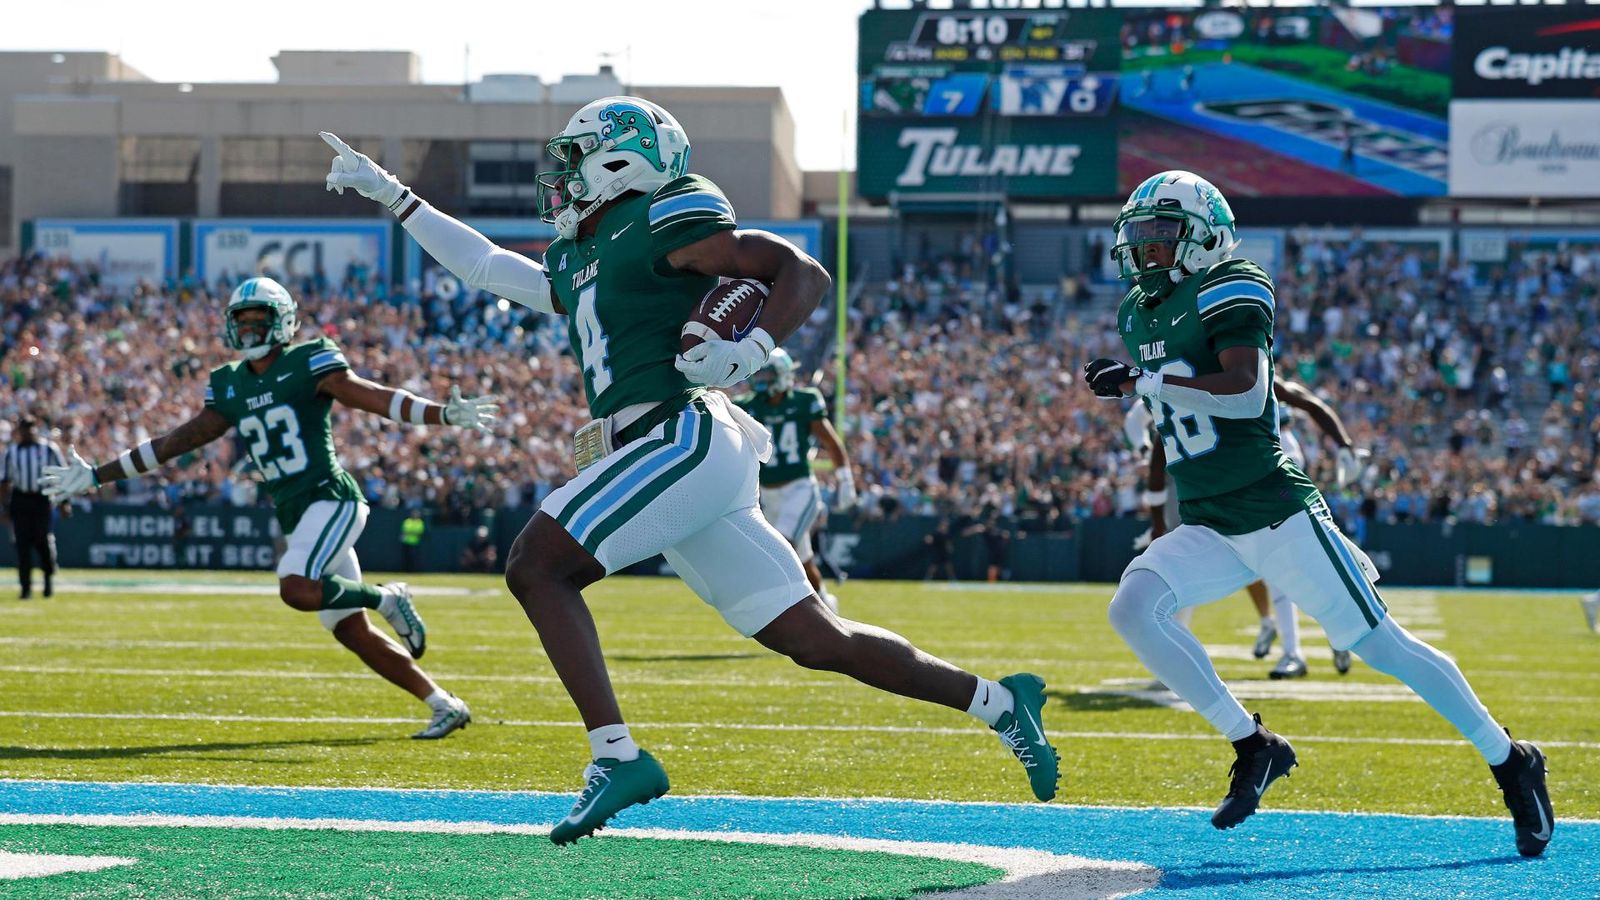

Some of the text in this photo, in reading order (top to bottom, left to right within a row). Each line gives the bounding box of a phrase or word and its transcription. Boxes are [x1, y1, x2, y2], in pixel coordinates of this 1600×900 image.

[936, 15, 1008, 45] 8:10
[1474, 46, 1600, 85] Capita
[942, 91, 964, 112] 7
[896, 127, 1082, 187] TULANE
[572, 259, 600, 291] TULANE
[576, 282, 614, 398] 4
[1138, 340, 1167, 362] TULANE
[246, 391, 274, 411] TULANE
[238, 404, 309, 482] 23
[104, 515, 225, 538] MICHEL
